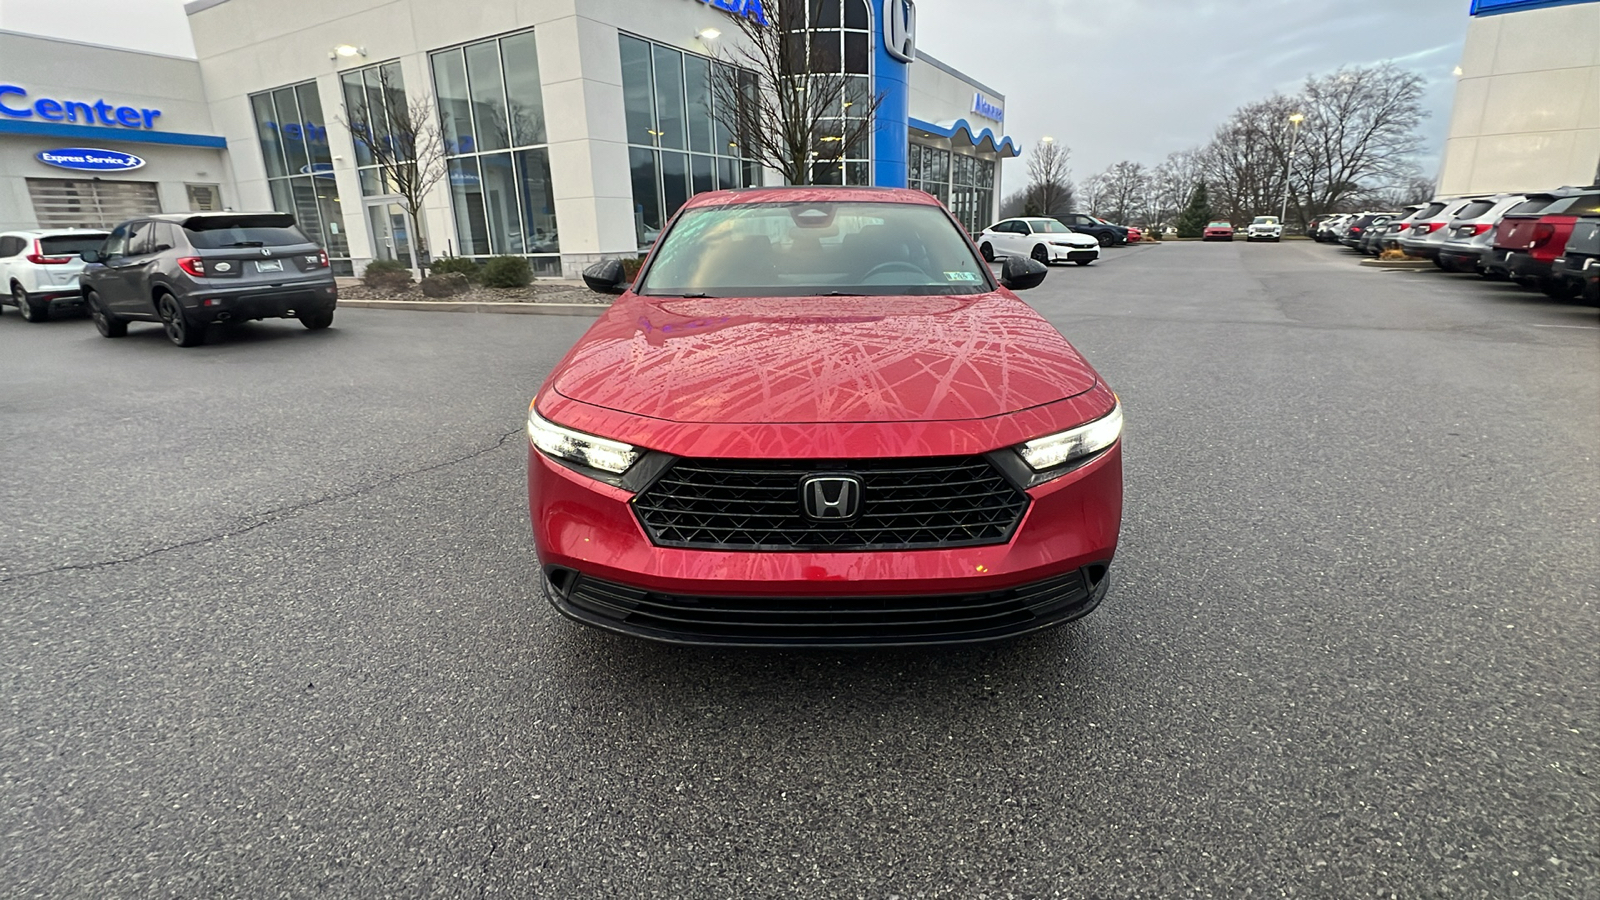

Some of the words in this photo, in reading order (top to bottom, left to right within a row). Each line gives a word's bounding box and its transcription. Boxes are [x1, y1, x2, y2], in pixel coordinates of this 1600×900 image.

[0, 85, 161, 129] Center
[42, 152, 85, 164] Express
[85, 154, 124, 165] Service
